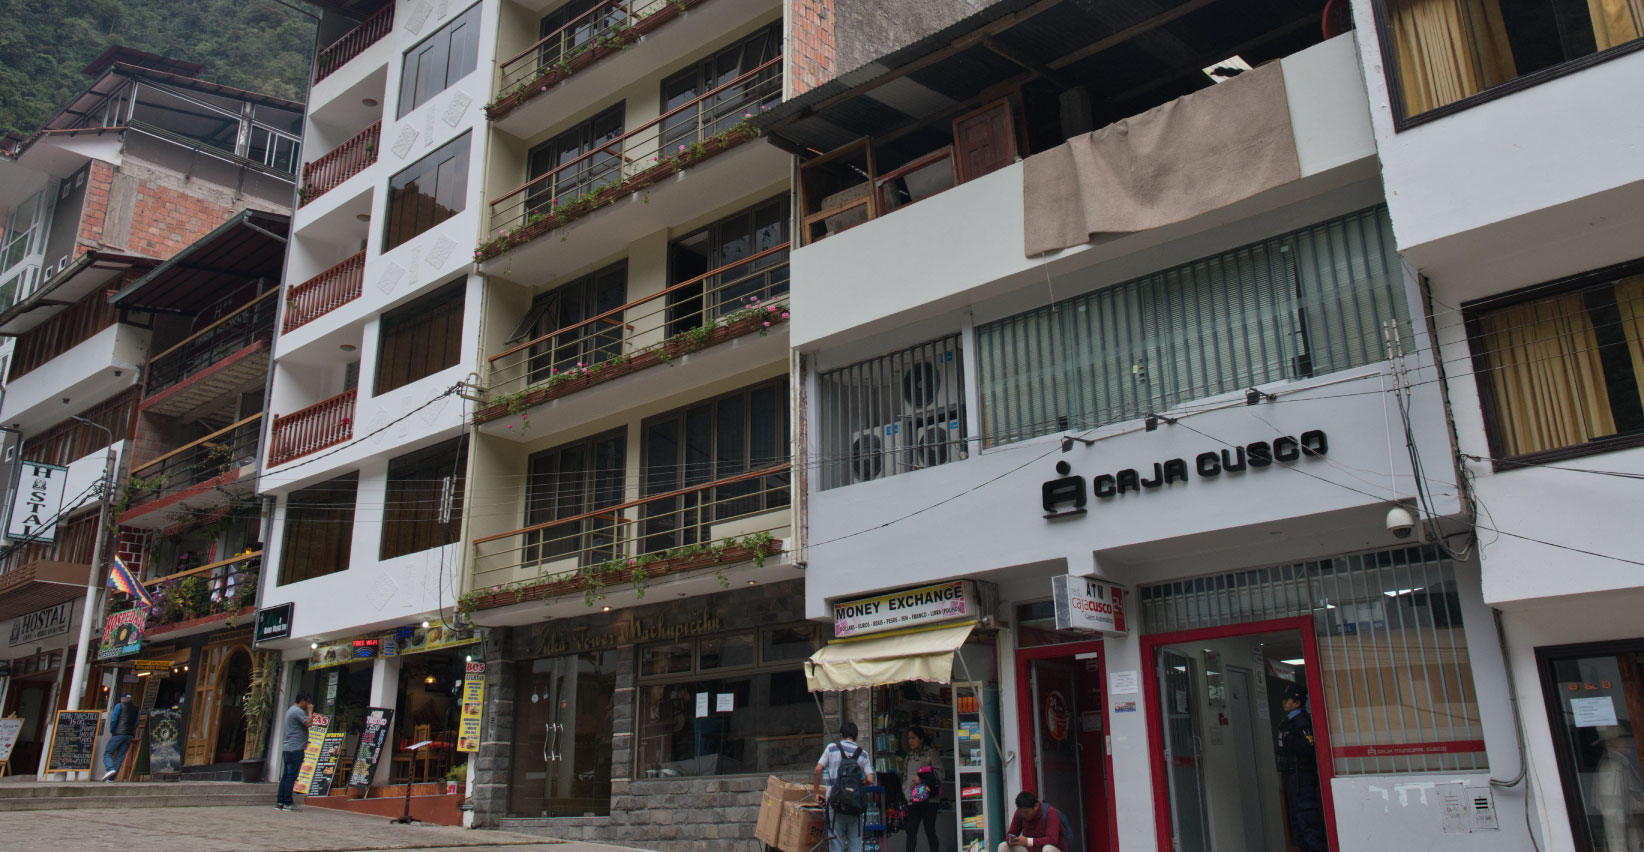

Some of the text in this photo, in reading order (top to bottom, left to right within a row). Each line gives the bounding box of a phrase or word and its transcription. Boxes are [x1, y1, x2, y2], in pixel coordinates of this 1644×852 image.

[1094, 429, 1329, 499] CAJA CUSCO
[836, 585, 963, 620] MONEY EXCHANGE
[1086, 583, 1104, 600] ATM
[21, 605, 66, 634] HOSTAL
[101, 606, 148, 643] HOSPEDAJE
[573, 625, 616, 650] Tower
[622, 609, 721, 643] Machupicchu
